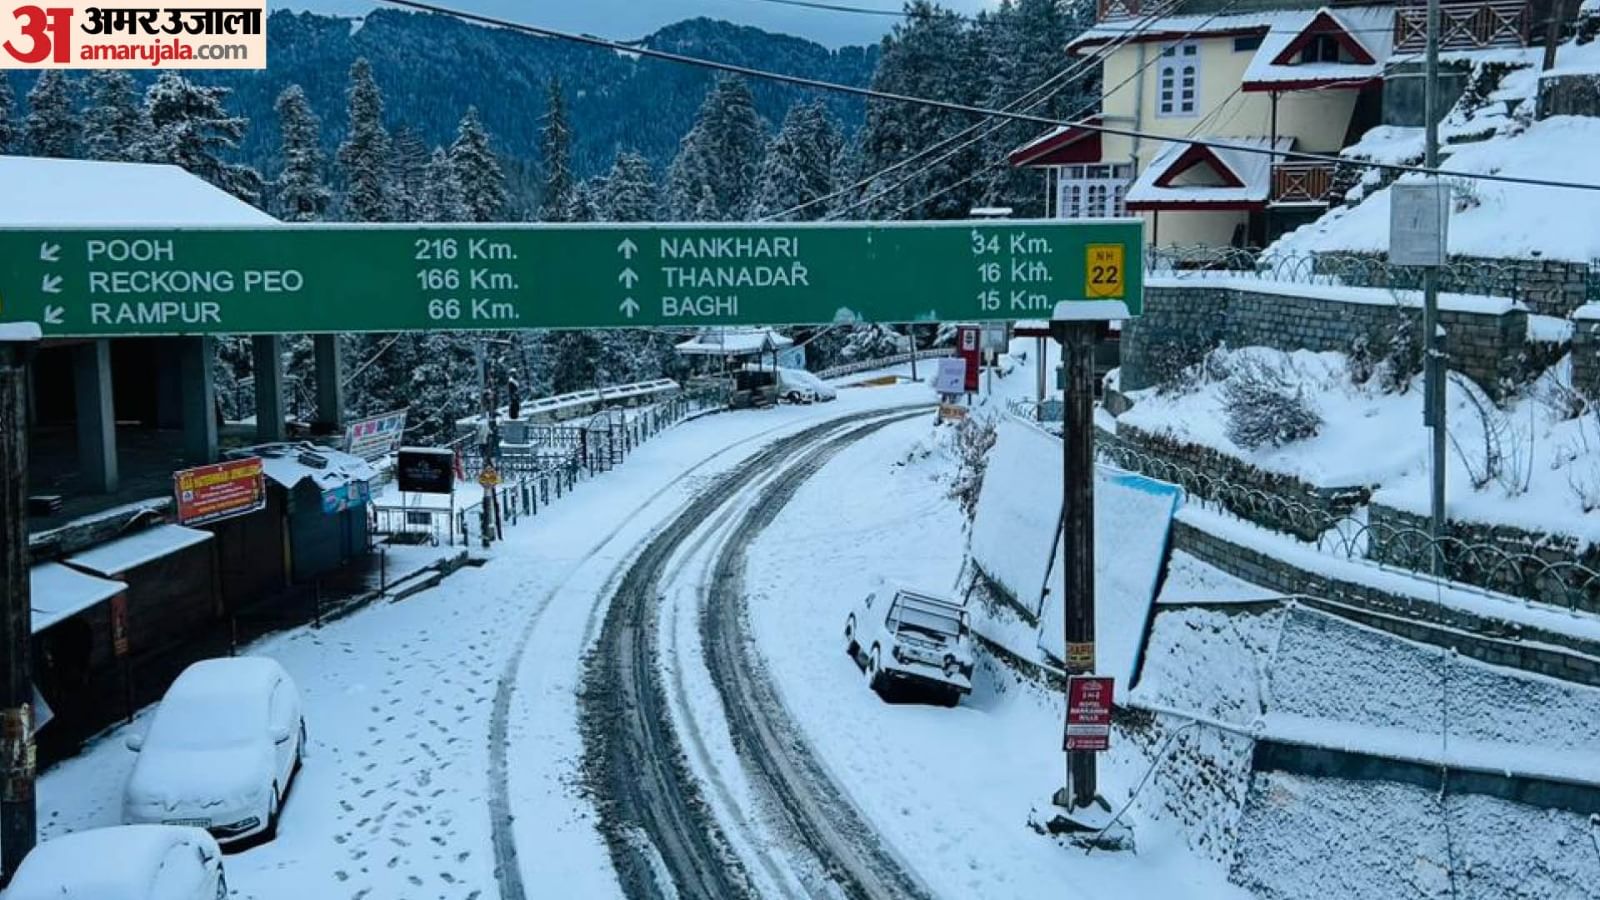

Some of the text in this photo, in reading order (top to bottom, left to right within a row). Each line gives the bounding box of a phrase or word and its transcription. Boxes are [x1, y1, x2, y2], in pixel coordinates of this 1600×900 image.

[87, 238, 518, 261] POOH 216 Km.
[661, 231, 1053, 259] NANKHARI 34 Km.
[1096, 251, 1114, 261] NH
[90, 268, 519, 294] RECKONG PEO 166 Km.
[662, 257, 1053, 288] THANADAR 16 Km.
[1092, 265, 1118, 284] 22
[91, 298, 520, 325] RAMPUR 66 Km.
[662, 290, 1053, 317] BAGHI 15 Km.
